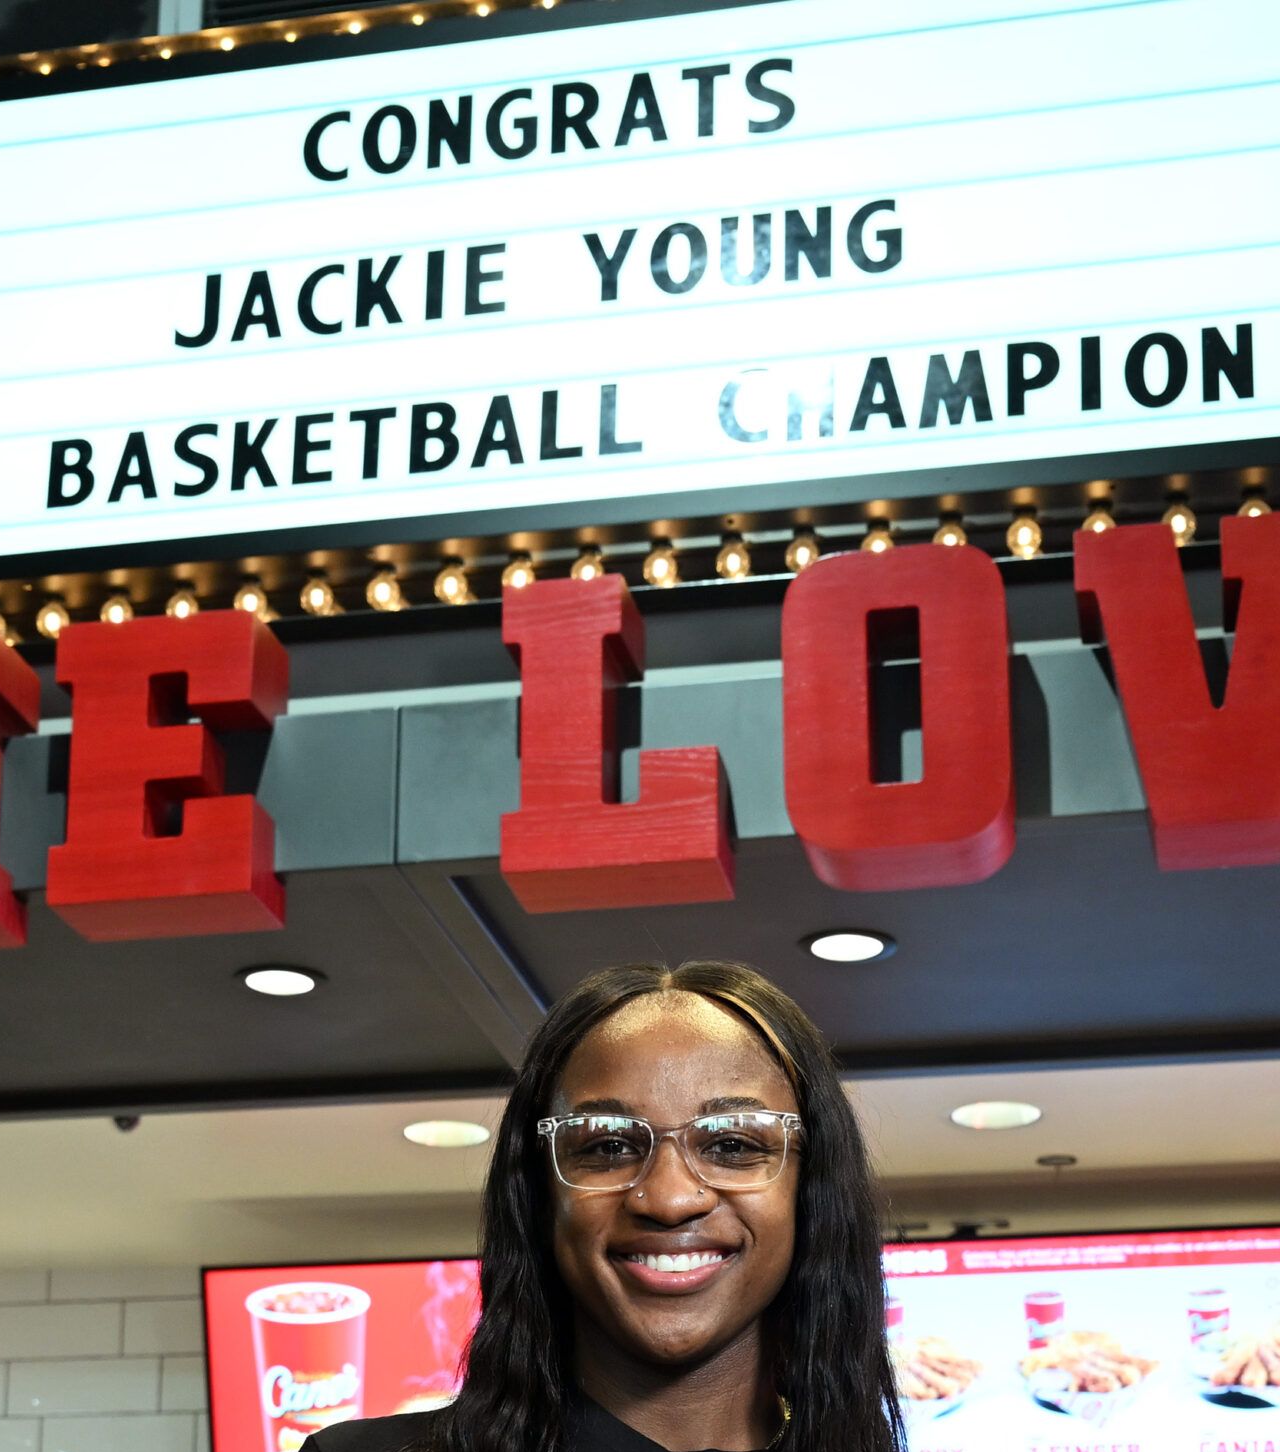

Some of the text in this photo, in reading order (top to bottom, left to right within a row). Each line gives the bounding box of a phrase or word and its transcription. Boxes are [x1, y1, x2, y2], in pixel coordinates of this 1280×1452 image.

[303, 58, 796, 181] CONGRATS
[175, 200, 903, 348] JACKIE YOUNG
[47, 383, 643, 509] BASKETBALL
